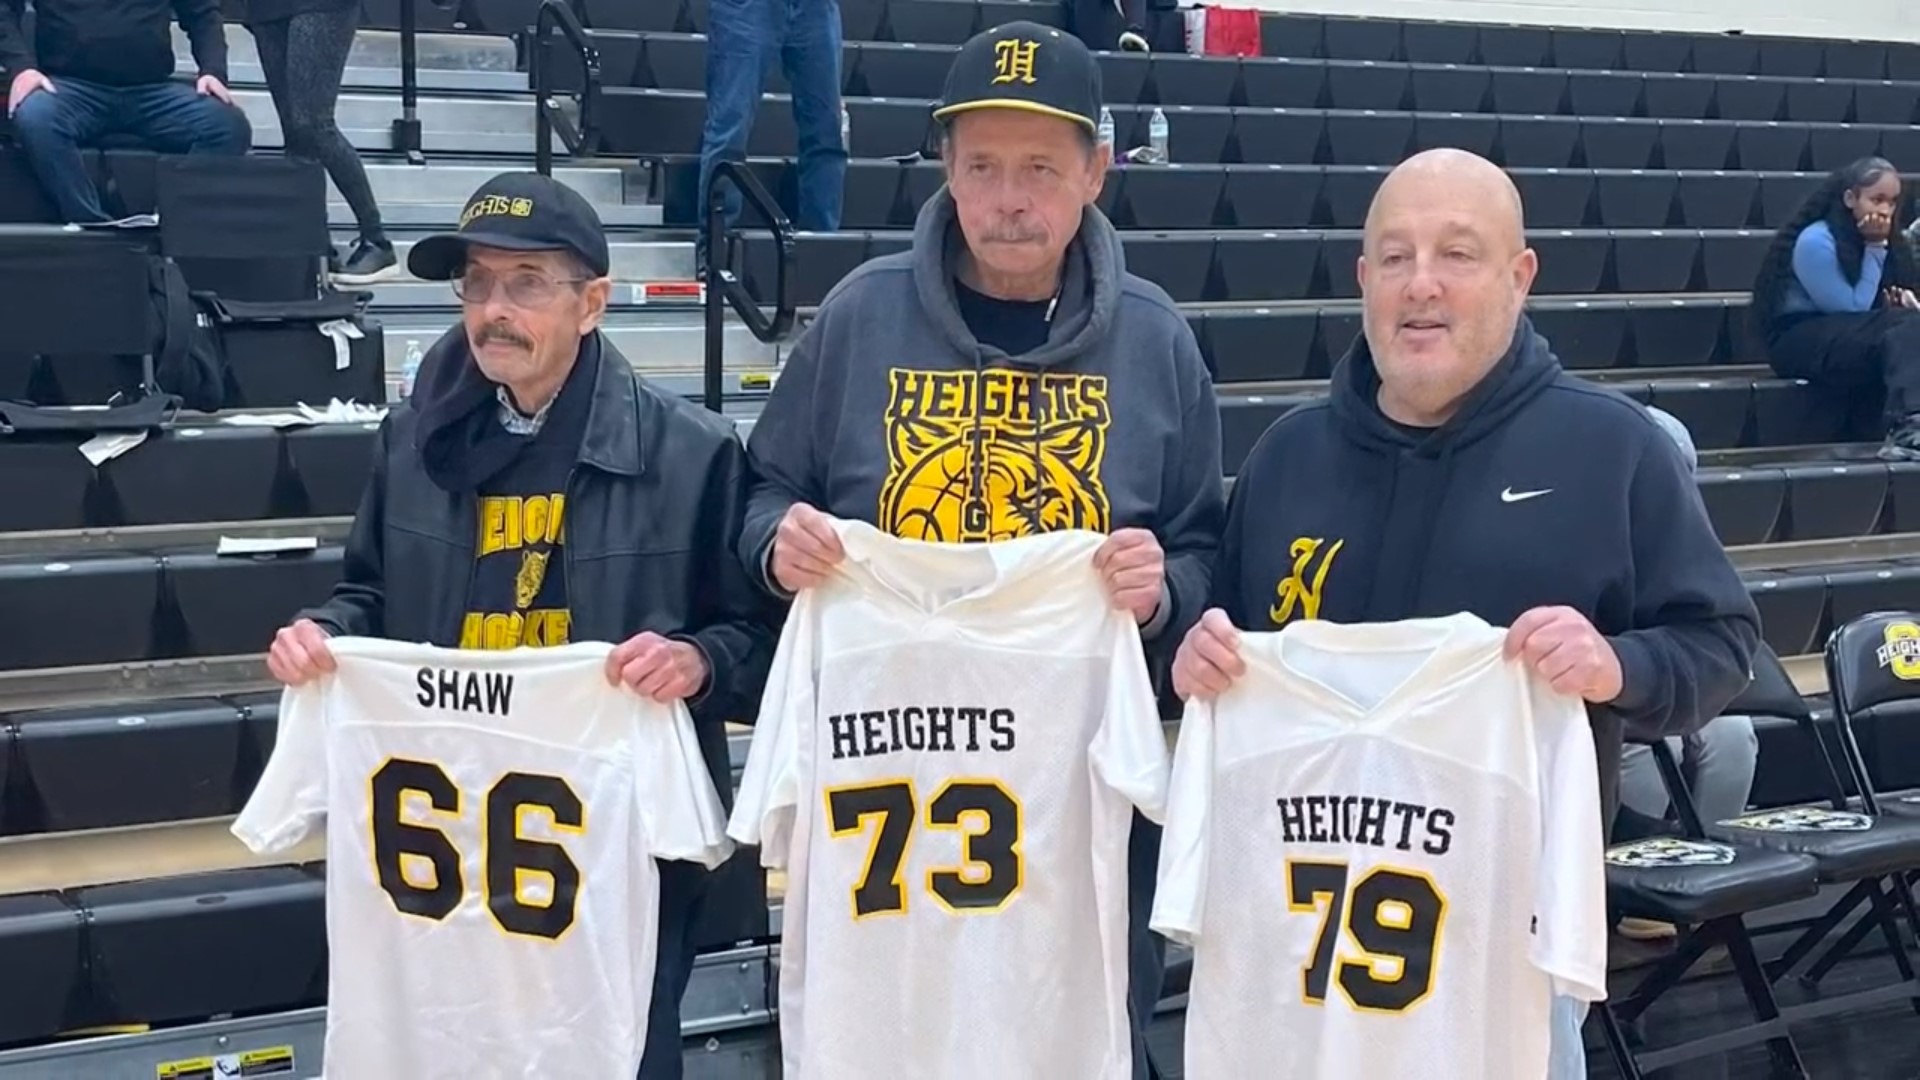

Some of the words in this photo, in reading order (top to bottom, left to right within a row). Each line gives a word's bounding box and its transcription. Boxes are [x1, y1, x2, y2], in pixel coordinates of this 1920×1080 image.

[991, 38, 1041, 84] H
[885, 368, 1111, 427] HEIGHTS
[963, 426, 992, 543] TIG
[416, 666, 514, 716] SHAW
[829, 706, 1016, 760] HEIGHTS
[366, 755, 588, 942] 66
[822, 775, 1025, 922] 73
[1276, 794, 1456, 856] HEIGHTS
[1283, 856, 1449, 1017] 79
